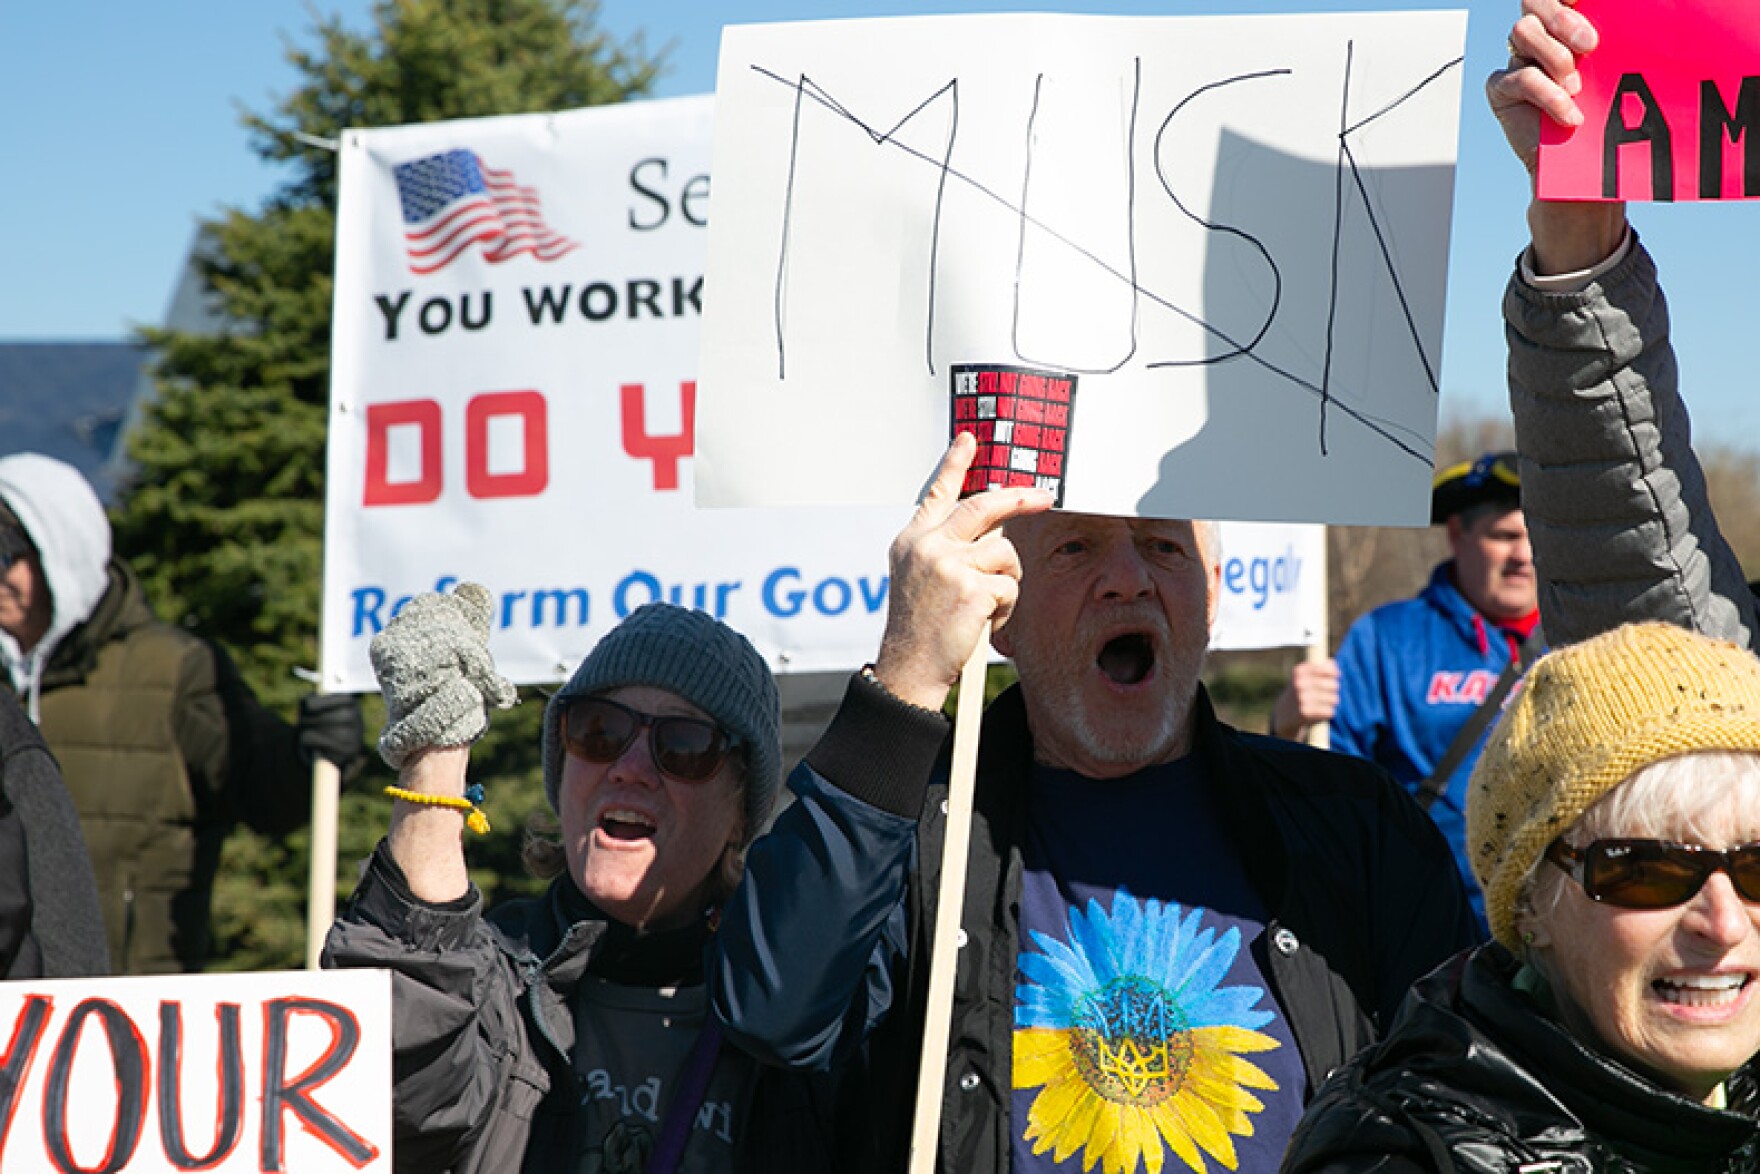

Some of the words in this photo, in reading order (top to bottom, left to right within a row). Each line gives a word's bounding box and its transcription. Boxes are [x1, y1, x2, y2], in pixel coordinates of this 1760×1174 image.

[1602, 73, 1760, 202] AM
[628, 157, 711, 231] Se
[775, 40, 1463, 456] MUSK
[375, 291, 492, 340] YOU
[523, 276, 704, 325] WORK
[363, 389, 548, 507] DO
[761, 566, 889, 618] Gov
